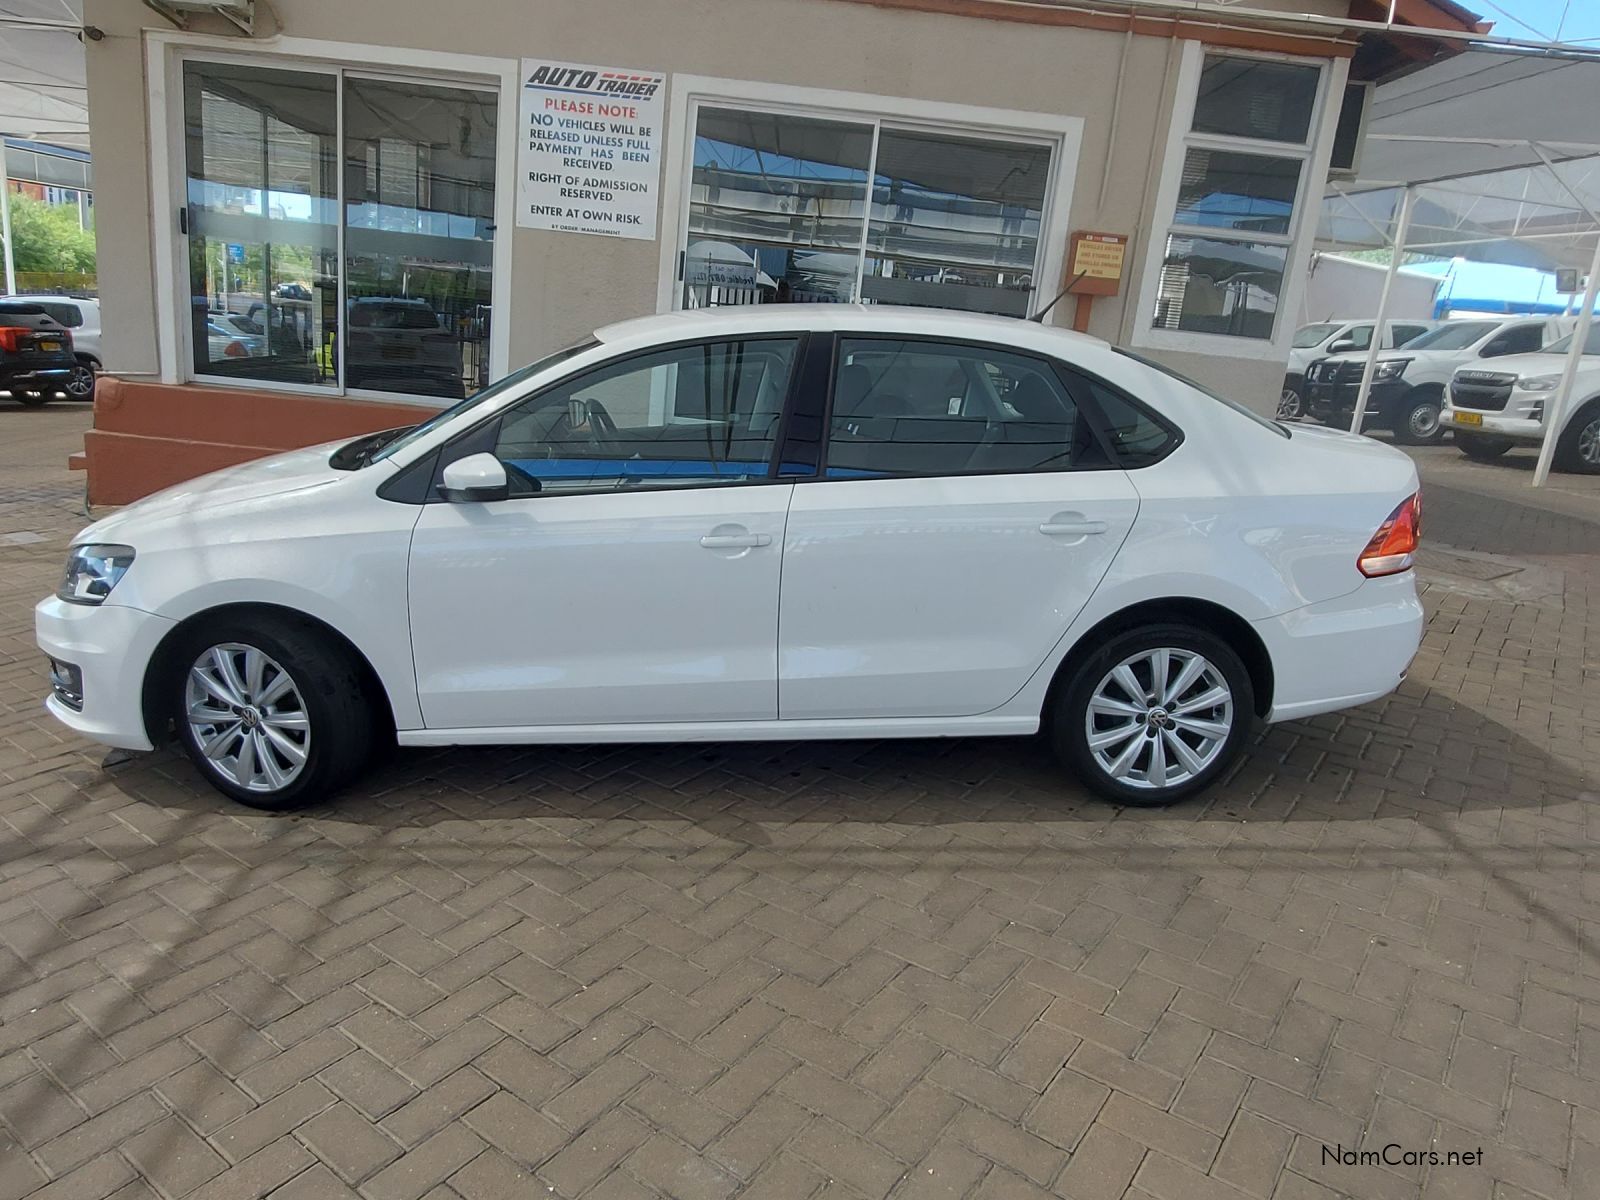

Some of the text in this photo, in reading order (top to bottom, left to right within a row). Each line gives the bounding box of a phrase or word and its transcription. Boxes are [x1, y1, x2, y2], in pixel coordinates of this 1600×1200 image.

[528, 66, 658, 96] AUTO TRADER
[545, 98, 593, 113] PLEASE
[531, 113, 651, 136] NO VEHICLES WILL BE
[530, 129, 650, 150] RELEASED UNLESS FULL
[530, 142, 649, 162] PAYMENT HAS BEEN
[529, 172, 647, 192] RIGHT OF ADMISSION
[531, 205, 562, 216] ENTER
[566, 209, 579, 218] AT
[583, 211, 612, 221] OWN
[582, 227, 621, 235] MANAGEMENT
